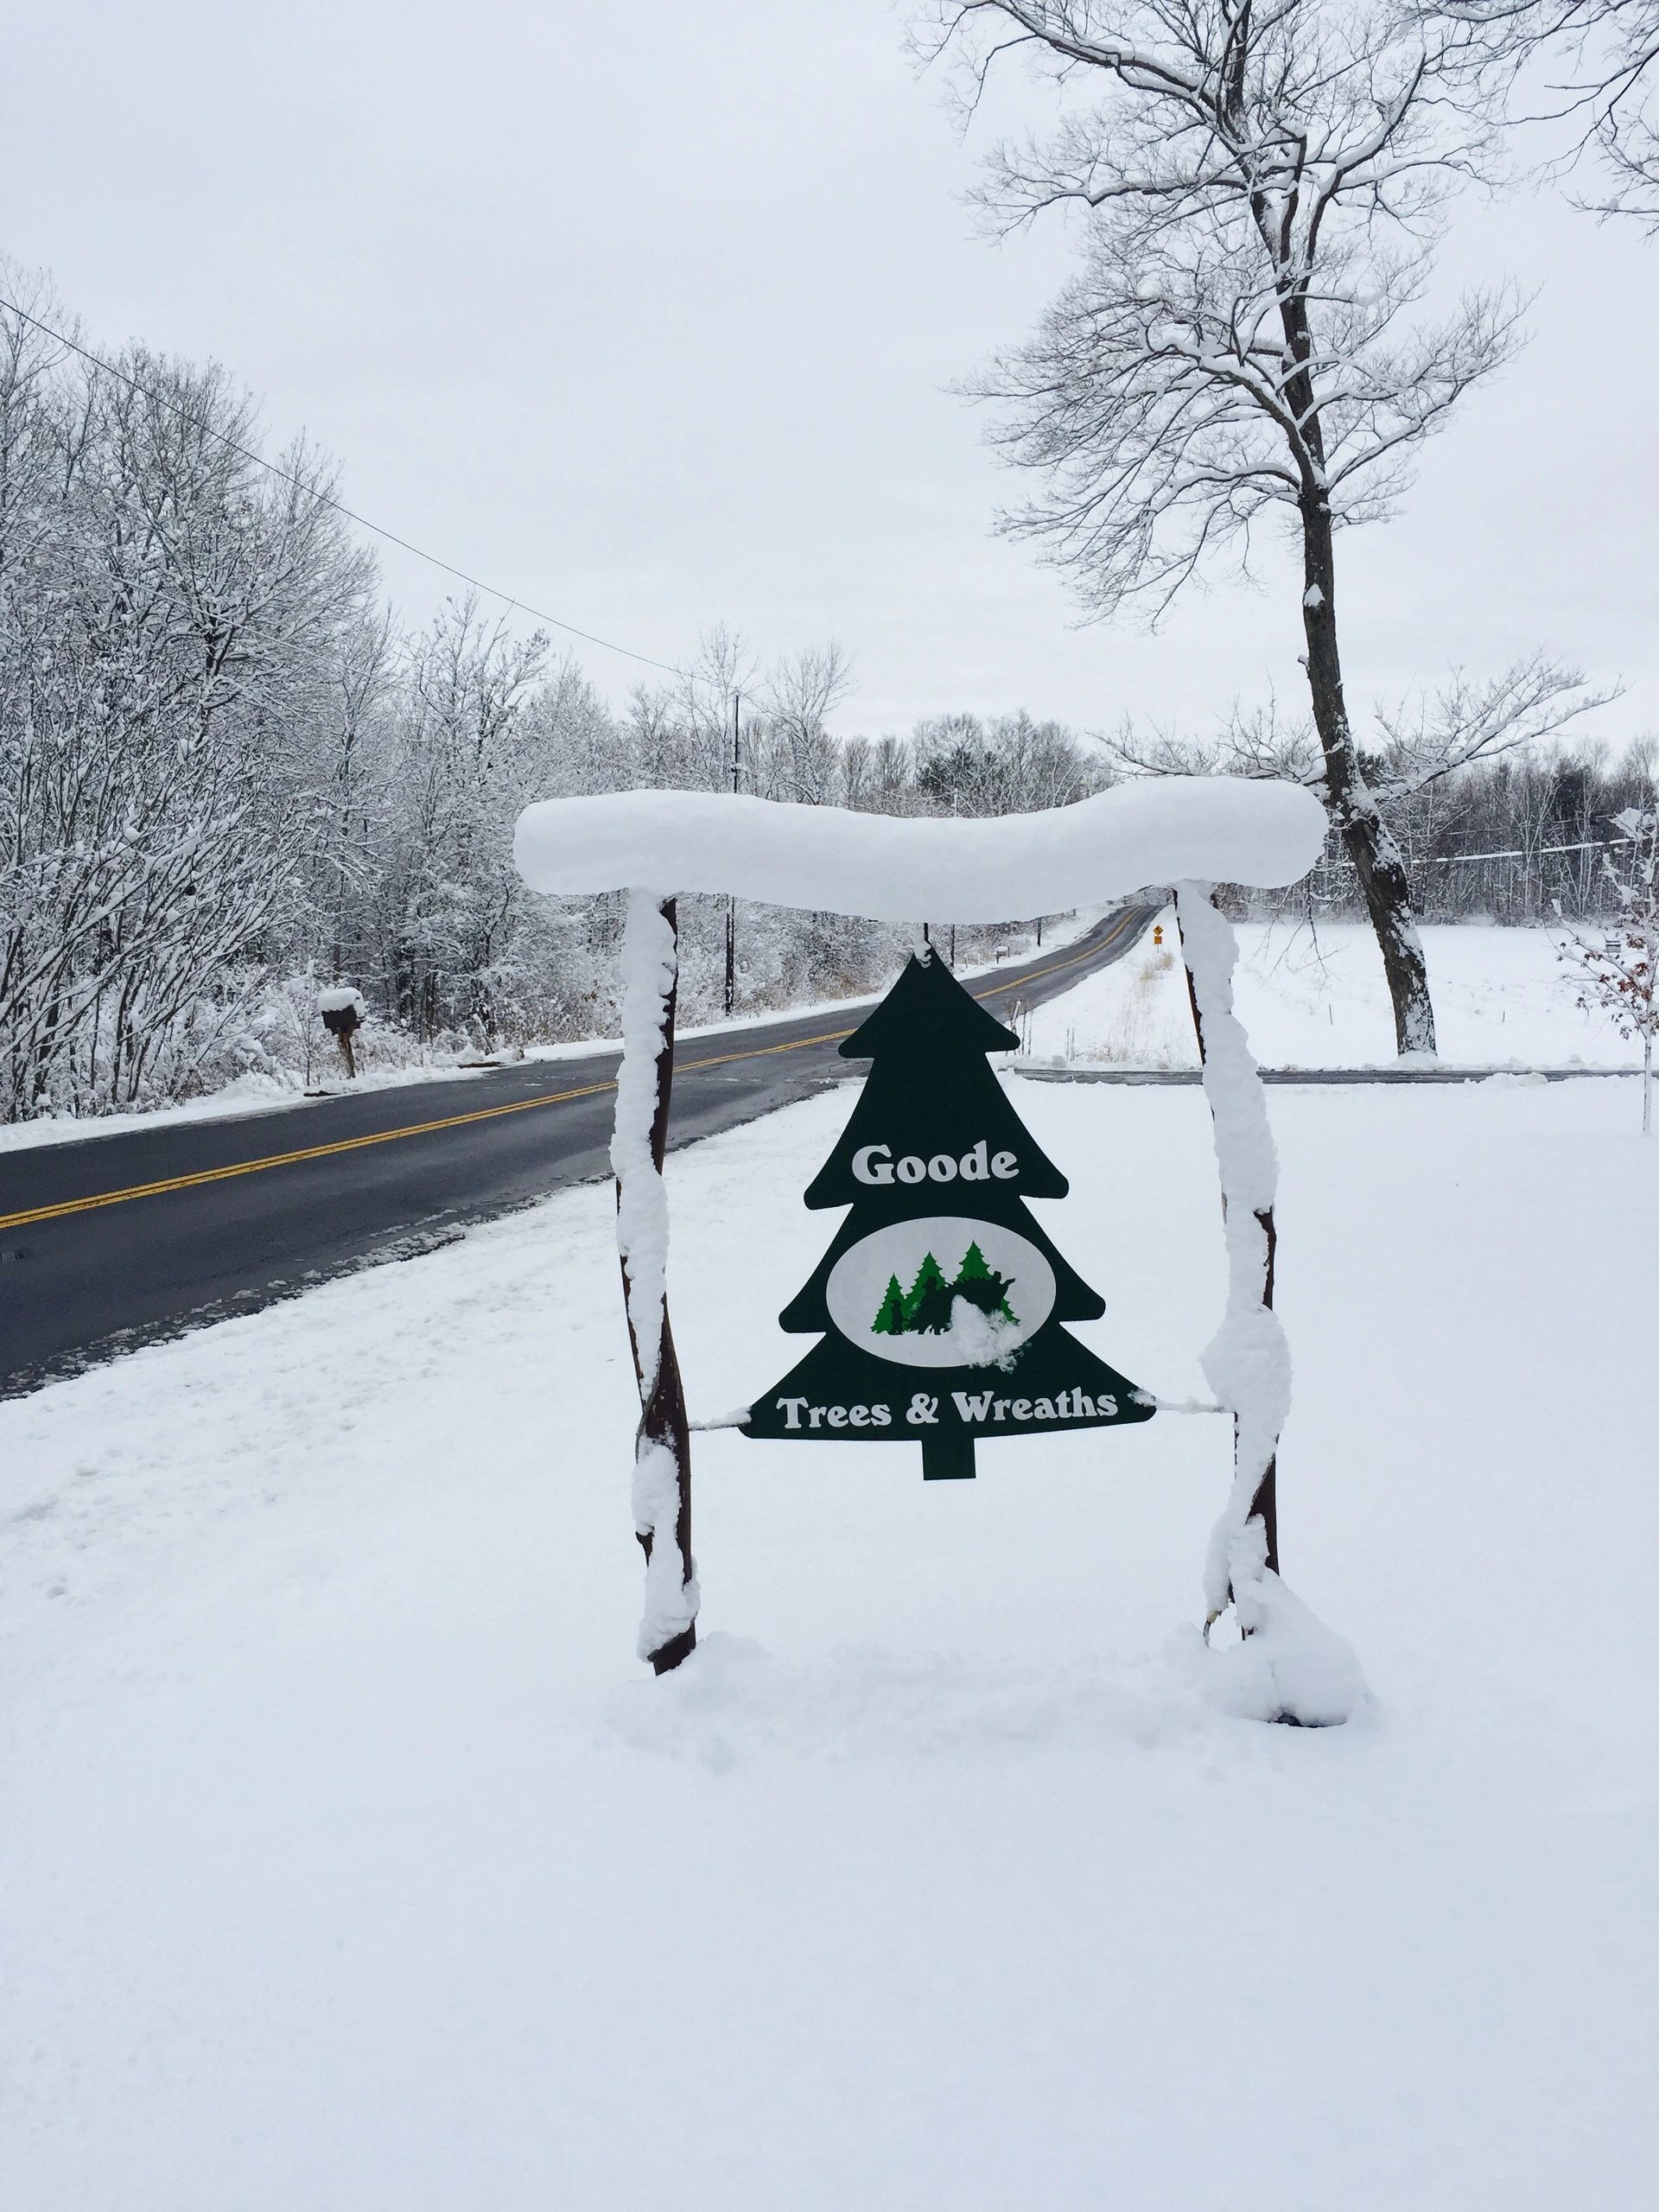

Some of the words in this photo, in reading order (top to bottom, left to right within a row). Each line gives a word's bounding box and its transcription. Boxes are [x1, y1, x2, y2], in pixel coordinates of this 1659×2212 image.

[851, 1140, 1020, 1185] Goode
[776, 1396, 893, 1429] Trees
[906, 1393, 939, 1425] &
[950, 1386, 1119, 1422] Wreaths
